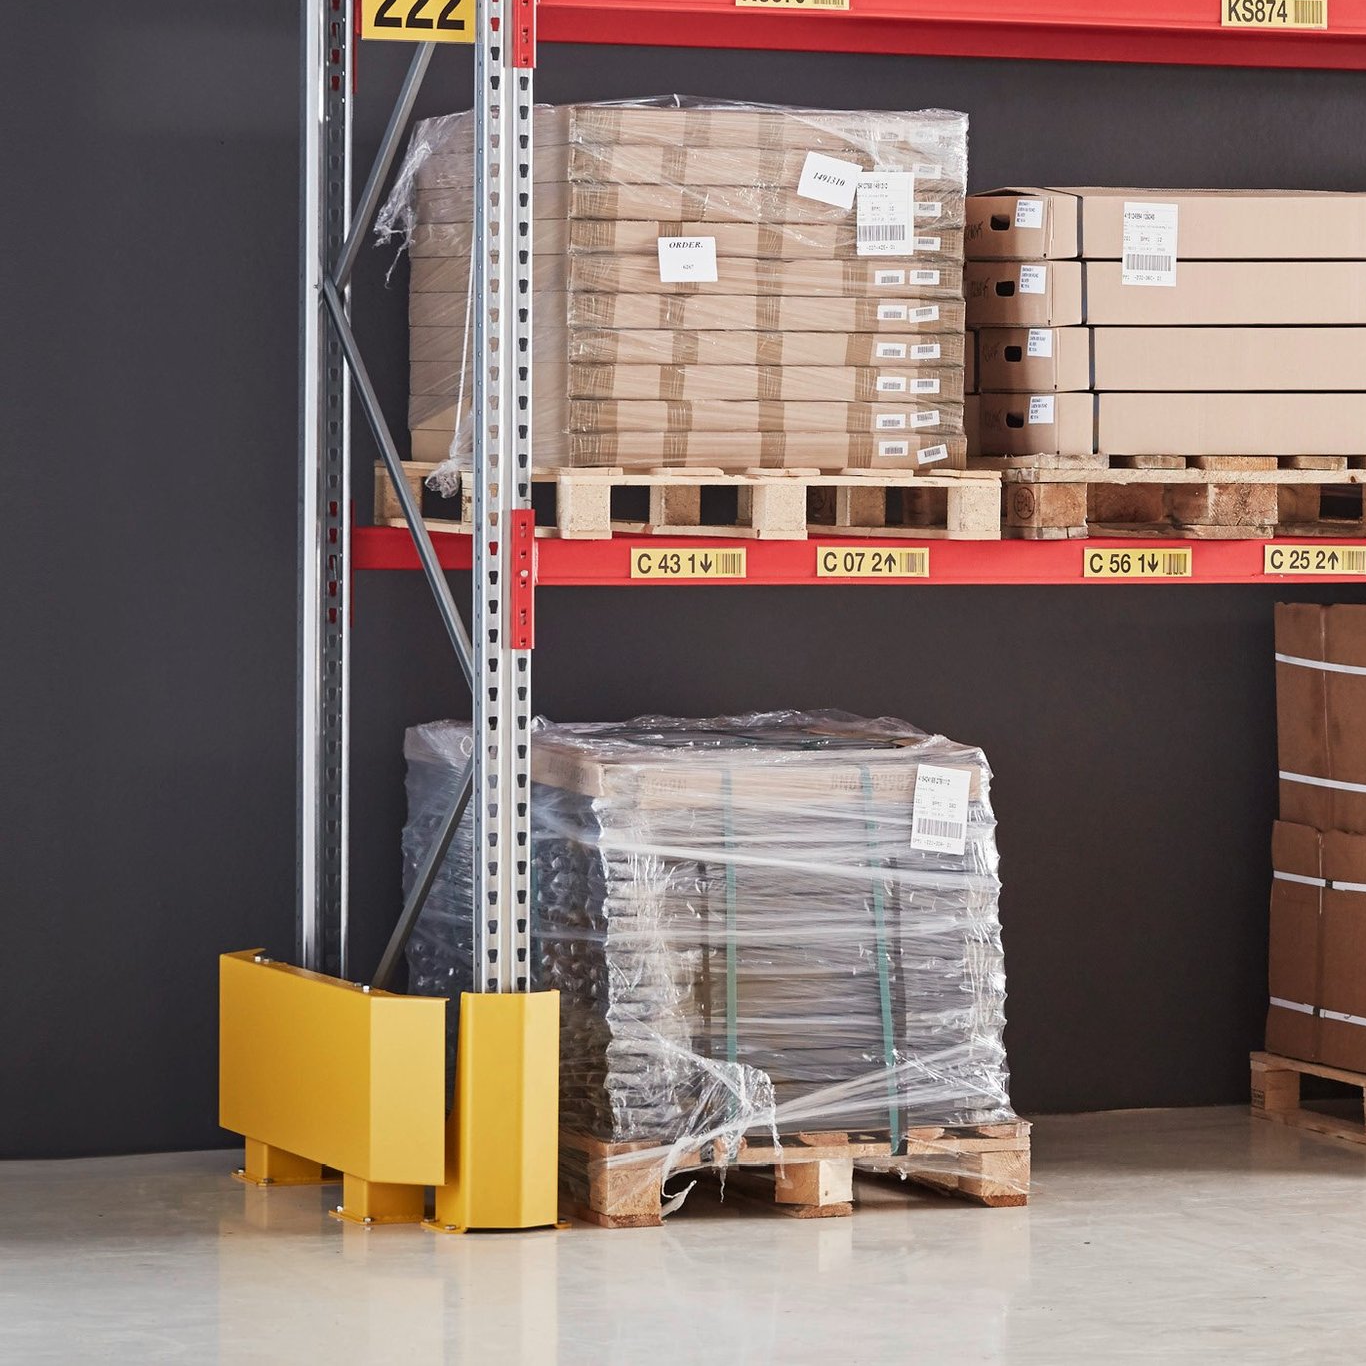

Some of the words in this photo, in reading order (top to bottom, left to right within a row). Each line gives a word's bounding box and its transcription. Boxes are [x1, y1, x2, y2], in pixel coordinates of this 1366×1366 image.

[637, 553, 652, 574] C
[658, 553, 681, 574] 43
[688, 554, 696, 573] 1
[823, 552, 838, 572] C
[843, 552, 865, 572] 07
[871, 552, 882, 572] 2
[1089, 553, 1103, 574] C
[1109, 553, 1131, 573] 56
[1138, 553, 1145, 573] 1
[1270, 549, 1284, 569] C
[1289, 550, 1310, 570] 25
[1315, 550, 1326, 569] 2
